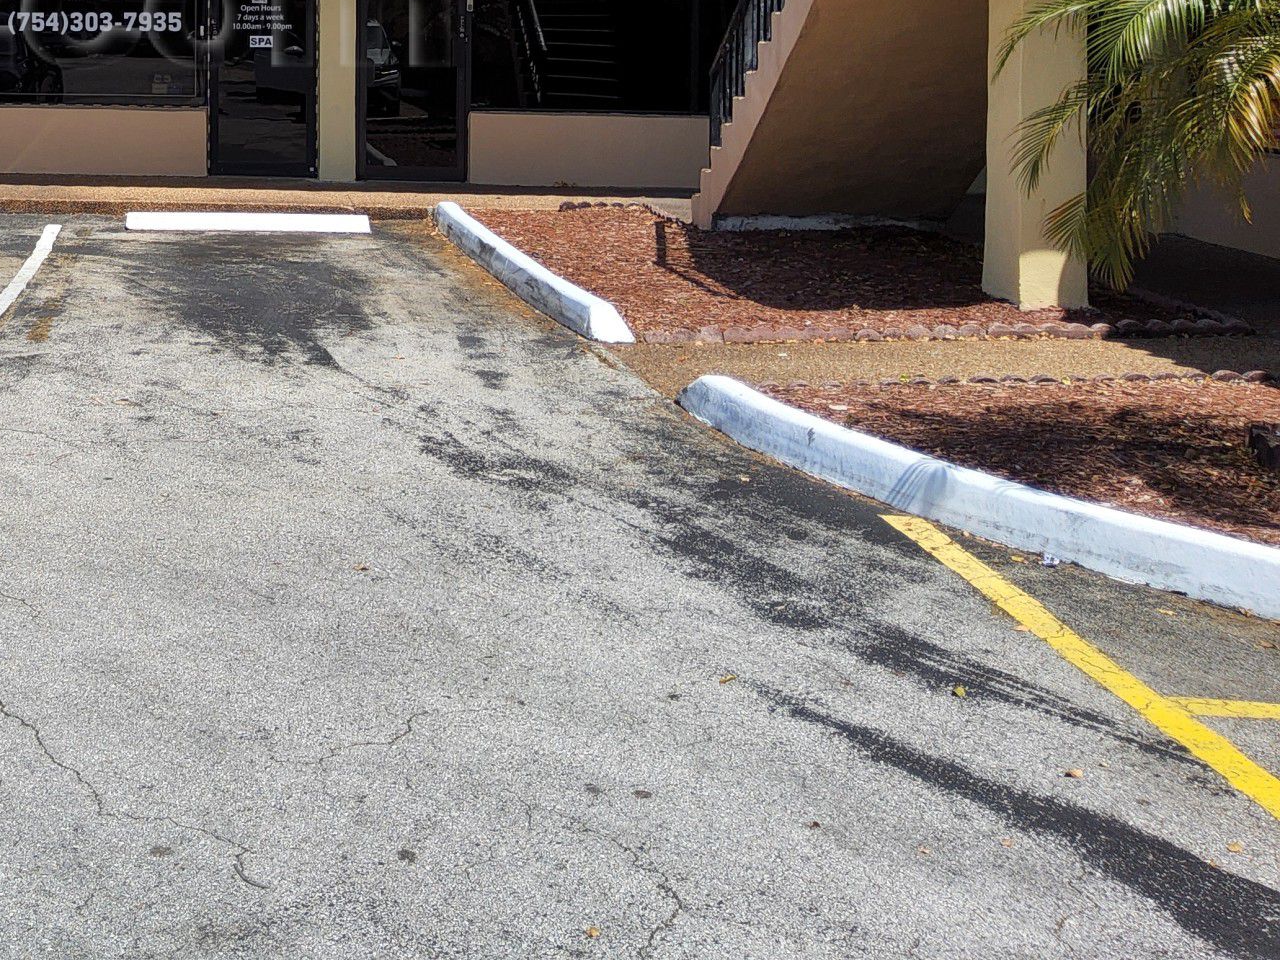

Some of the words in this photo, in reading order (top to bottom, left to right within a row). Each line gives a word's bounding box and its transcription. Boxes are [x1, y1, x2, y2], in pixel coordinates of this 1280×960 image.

[240, 5, 260, 13] Open
[243, 14, 259, 22] days
[7, 10, 182, 36] (754)303-7935
[250, 37, 272, 46] SPA
